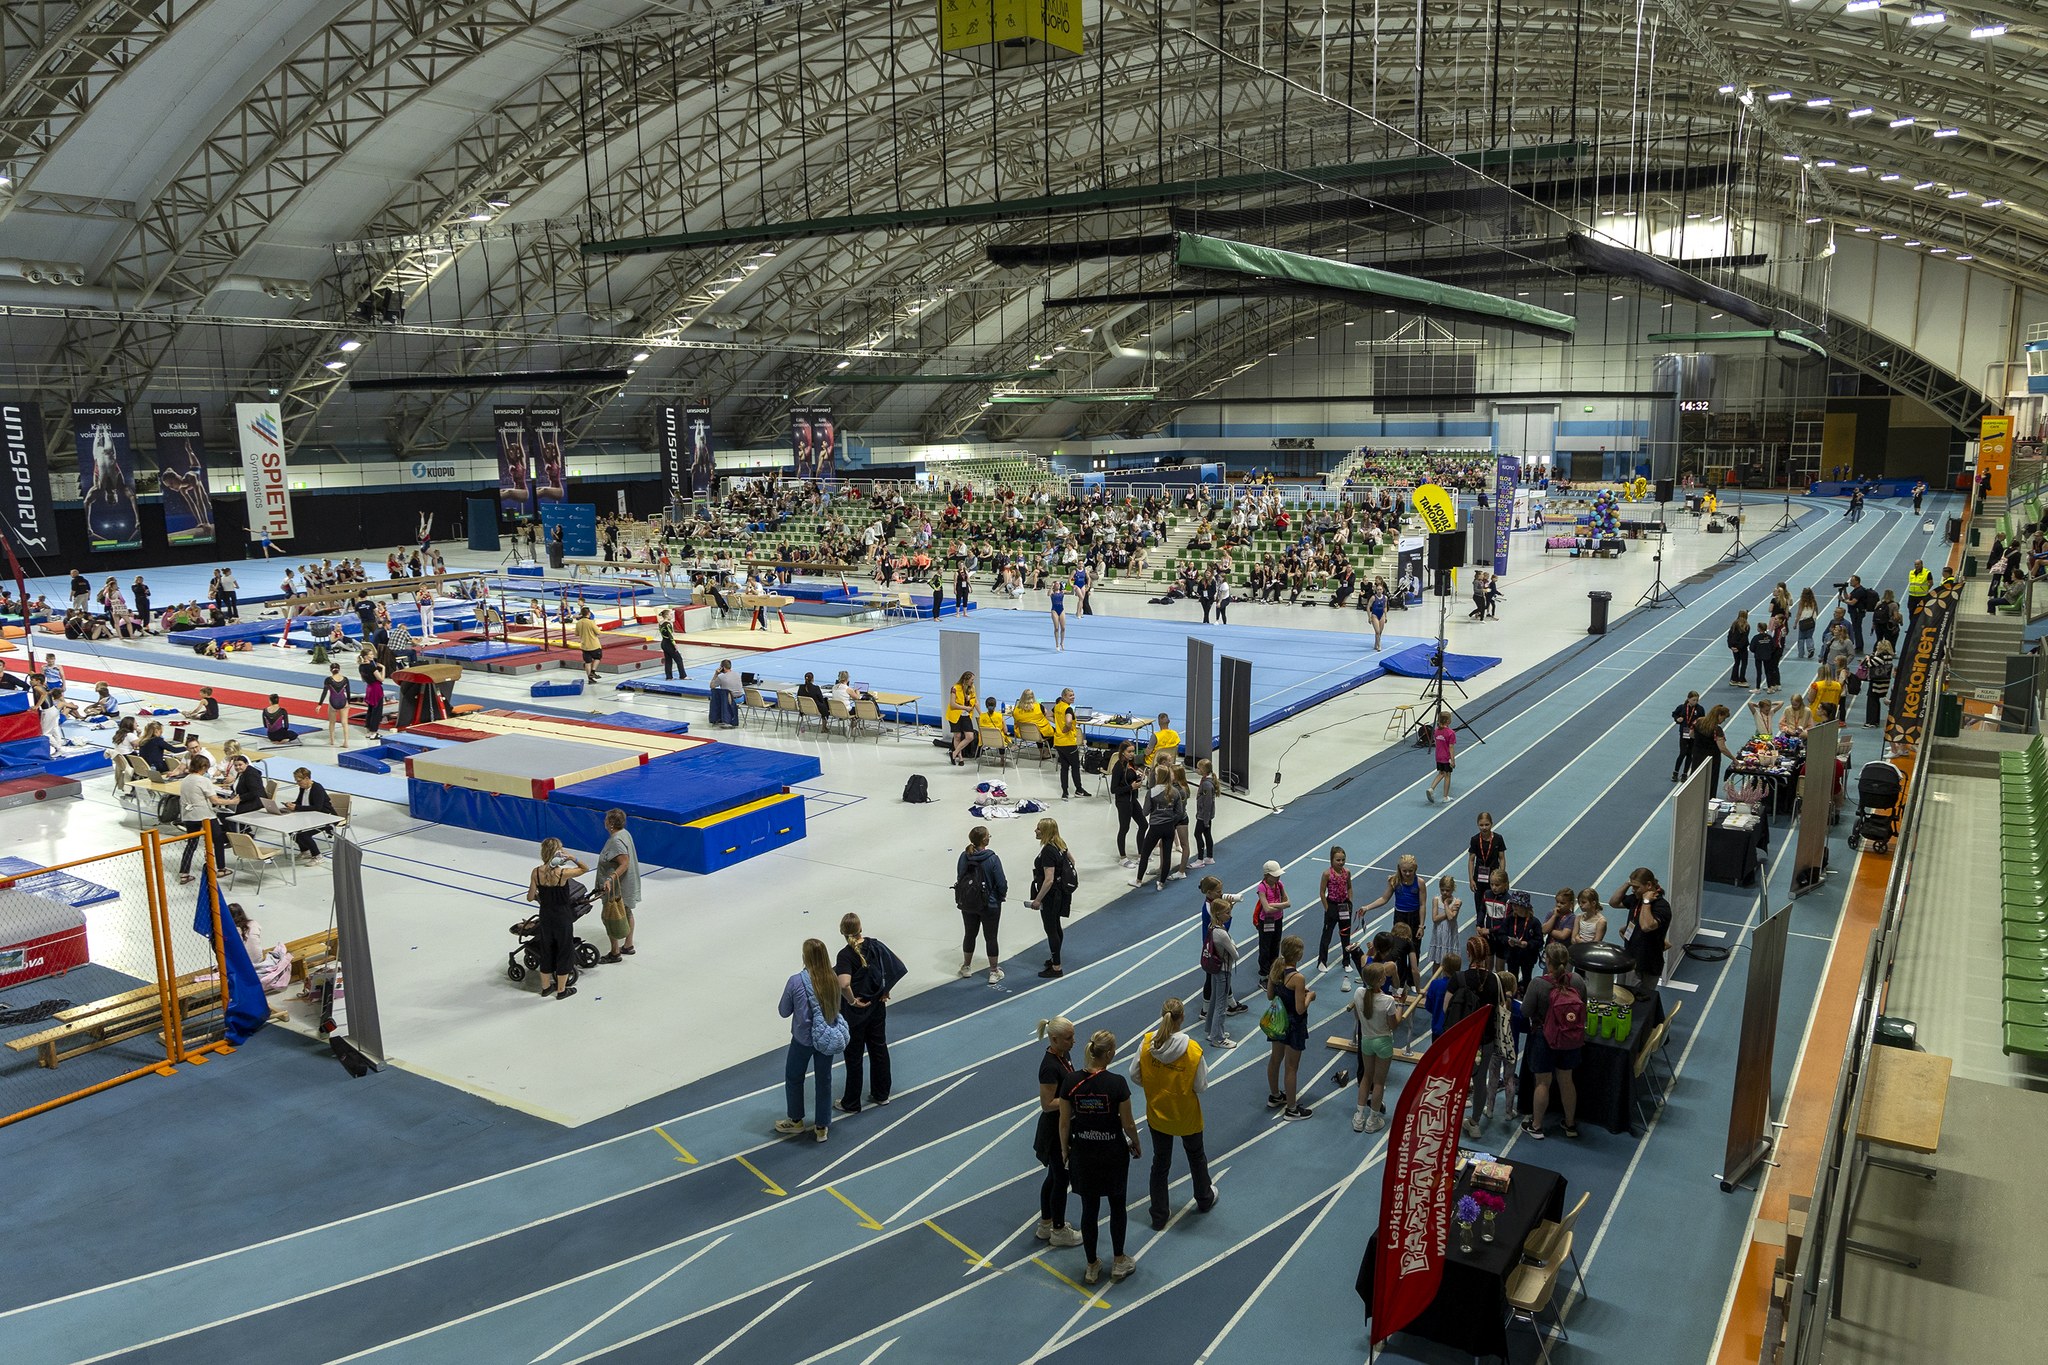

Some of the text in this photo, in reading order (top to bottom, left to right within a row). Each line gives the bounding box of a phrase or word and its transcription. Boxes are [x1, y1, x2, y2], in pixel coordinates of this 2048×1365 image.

[159, 430, 200, 438] voimisteluun
[1680, 401, 1709, 411] 14:32
[249, 453, 263, 509] Gymnastics
[262, 452, 289, 536] SPIETH
[427, 467, 455, 477] KUOPIO
[1901, 627, 1937, 718] ketoinen
[1387, 1112, 1415, 1250] Leikissä mukana
[1398, 1075, 1456, 1280] PARTANEN
